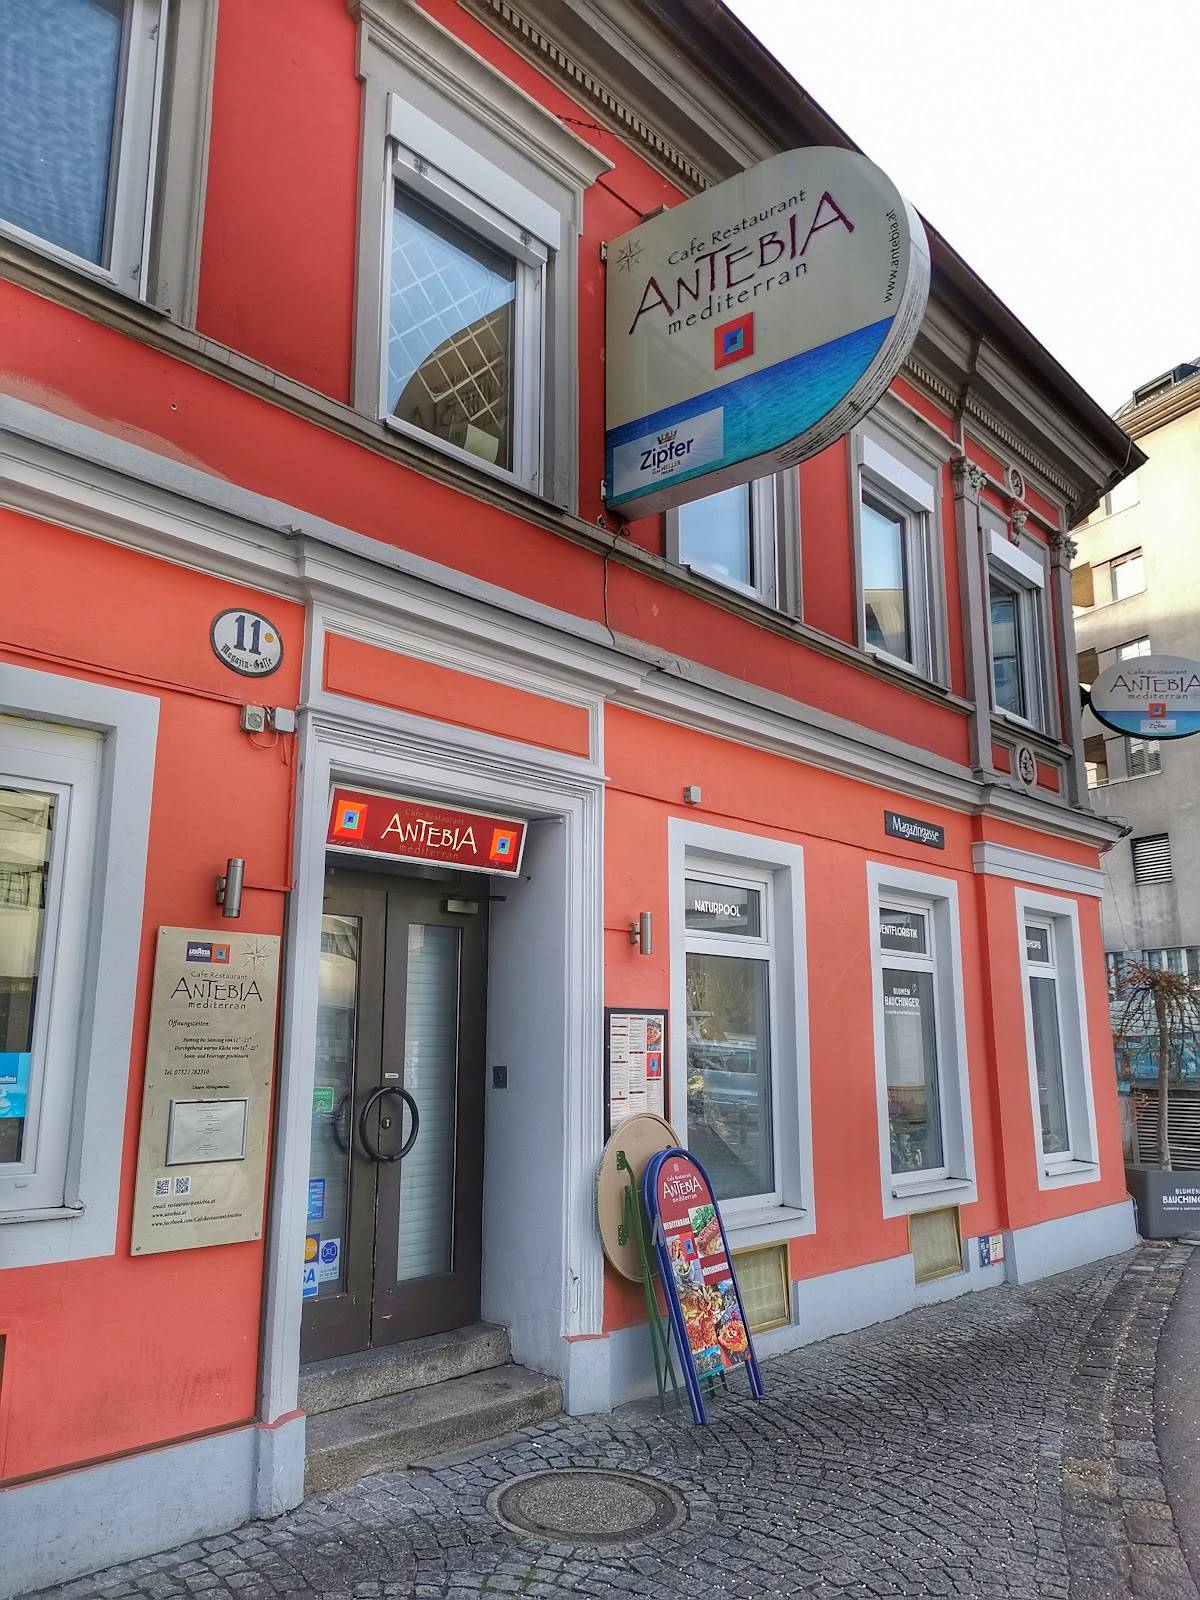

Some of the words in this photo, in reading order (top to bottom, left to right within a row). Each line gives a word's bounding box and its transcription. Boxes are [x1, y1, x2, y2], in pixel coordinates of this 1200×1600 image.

[668, 237, 705, 265] Cafe
[711, 189, 806, 245] Restaurant
[629, 191, 855, 335] ANTEBIA
[883, 208, 901, 303] www.antebia.at
[668, 262, 808, 335] mediterran
[640, 438, 694, 470] Zipfer
[233, 614, 262, 656] 11
[1128, 691, 1188, 700] mediterran
[405, 808, 424, 818] Cafe
[425, 811, 464, 825] Restaurant
[892, 815, 940, 842] Magazingasse
[380, 812, 478, 855] ANTEBIA
[399, 844, 459, 860] mediterran
[694, 899, 741, 917] NATURPOOL
[190, 970, 208, 978] Cafe
[210, 971, 248, 980] Restaurant
[170, 976, 262, 1002] ANTEBIA
[884, 995, 920, 1008] BAUCHINGER
[188, 998, 246, 1010] mediterran
